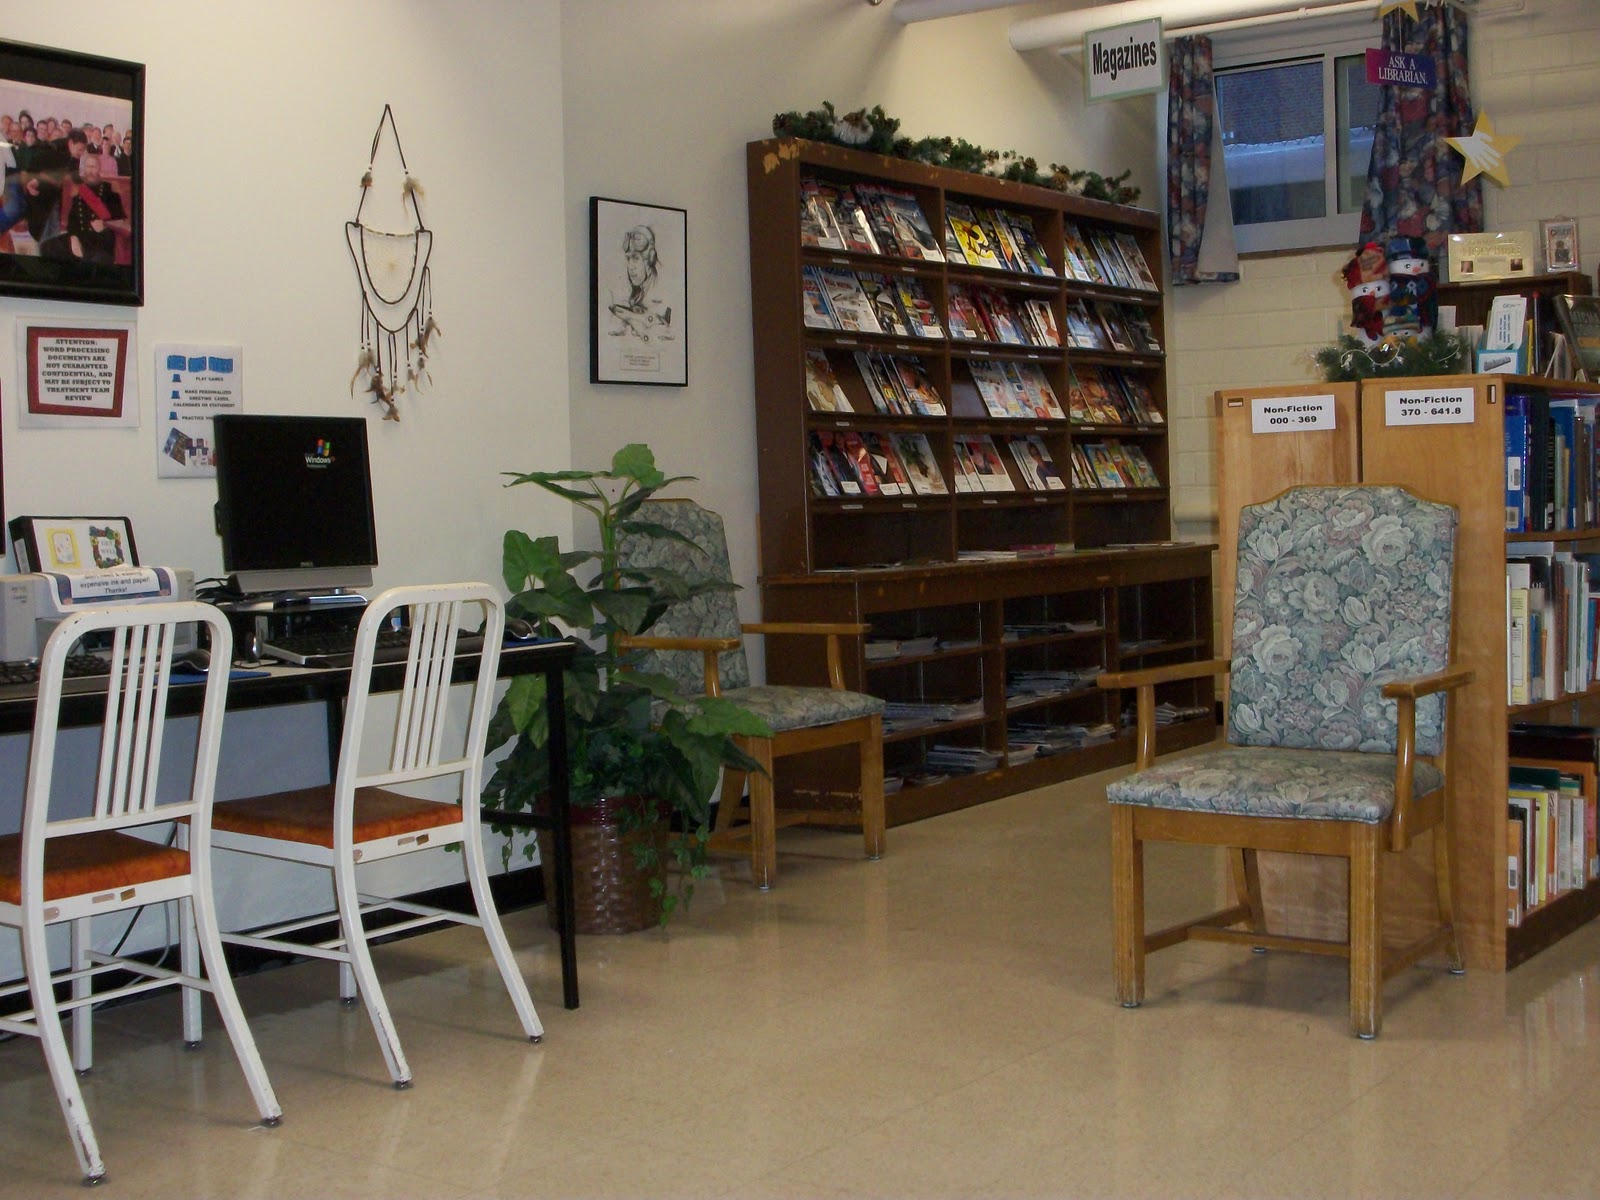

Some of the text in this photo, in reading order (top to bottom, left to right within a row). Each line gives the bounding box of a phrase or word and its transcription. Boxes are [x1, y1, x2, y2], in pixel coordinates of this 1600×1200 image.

[1092, 36, 1157, 81] Magazines
[1388, 56, 1416, 70] ASK A
[1399, 396, 1463, 405] Non-Fiction
[1264, 404, 1323, 414] Non-Fiction
[1401, 408, 1421, 416] 370
[1431, 407, 1462, 415] 641.8
[1270, 417, 1289, 425] 000
[1298, 415, 1317, 423] 369
[305, 456, 331, 464] Windows
[80, 580, 110, 588] expensive
[120, 577, 132, 585] and
